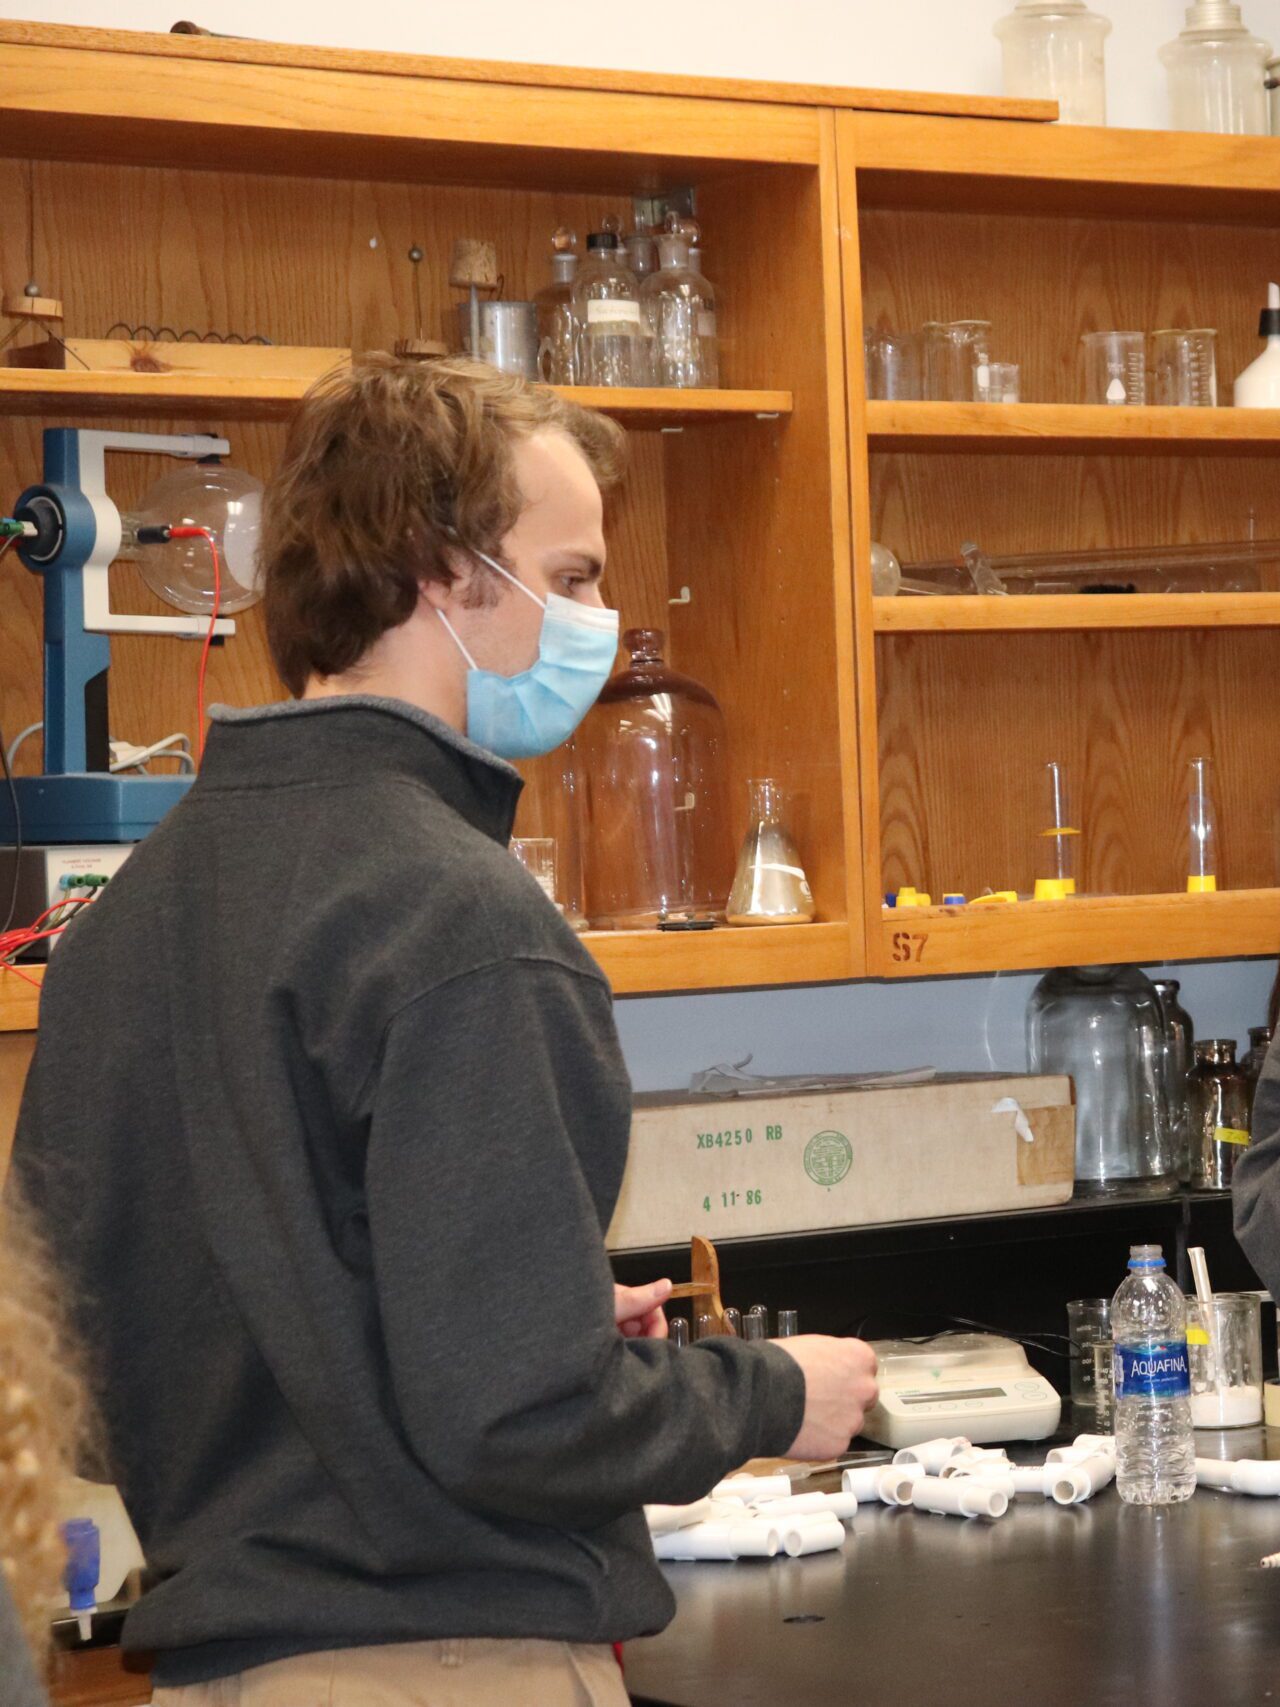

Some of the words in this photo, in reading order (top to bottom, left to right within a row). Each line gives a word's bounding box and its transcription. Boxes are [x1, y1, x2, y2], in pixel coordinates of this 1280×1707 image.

[892, 932, 929, 962] S7
[696, 1127, 753, 1149] XB4250
[765, 1124, 783, 1141] RB
[702, 1195, 711, 1212] 4
[746, 1189, 762, 1205] 86
[1130, 1355, 1188, 1378] AQUAFINA
